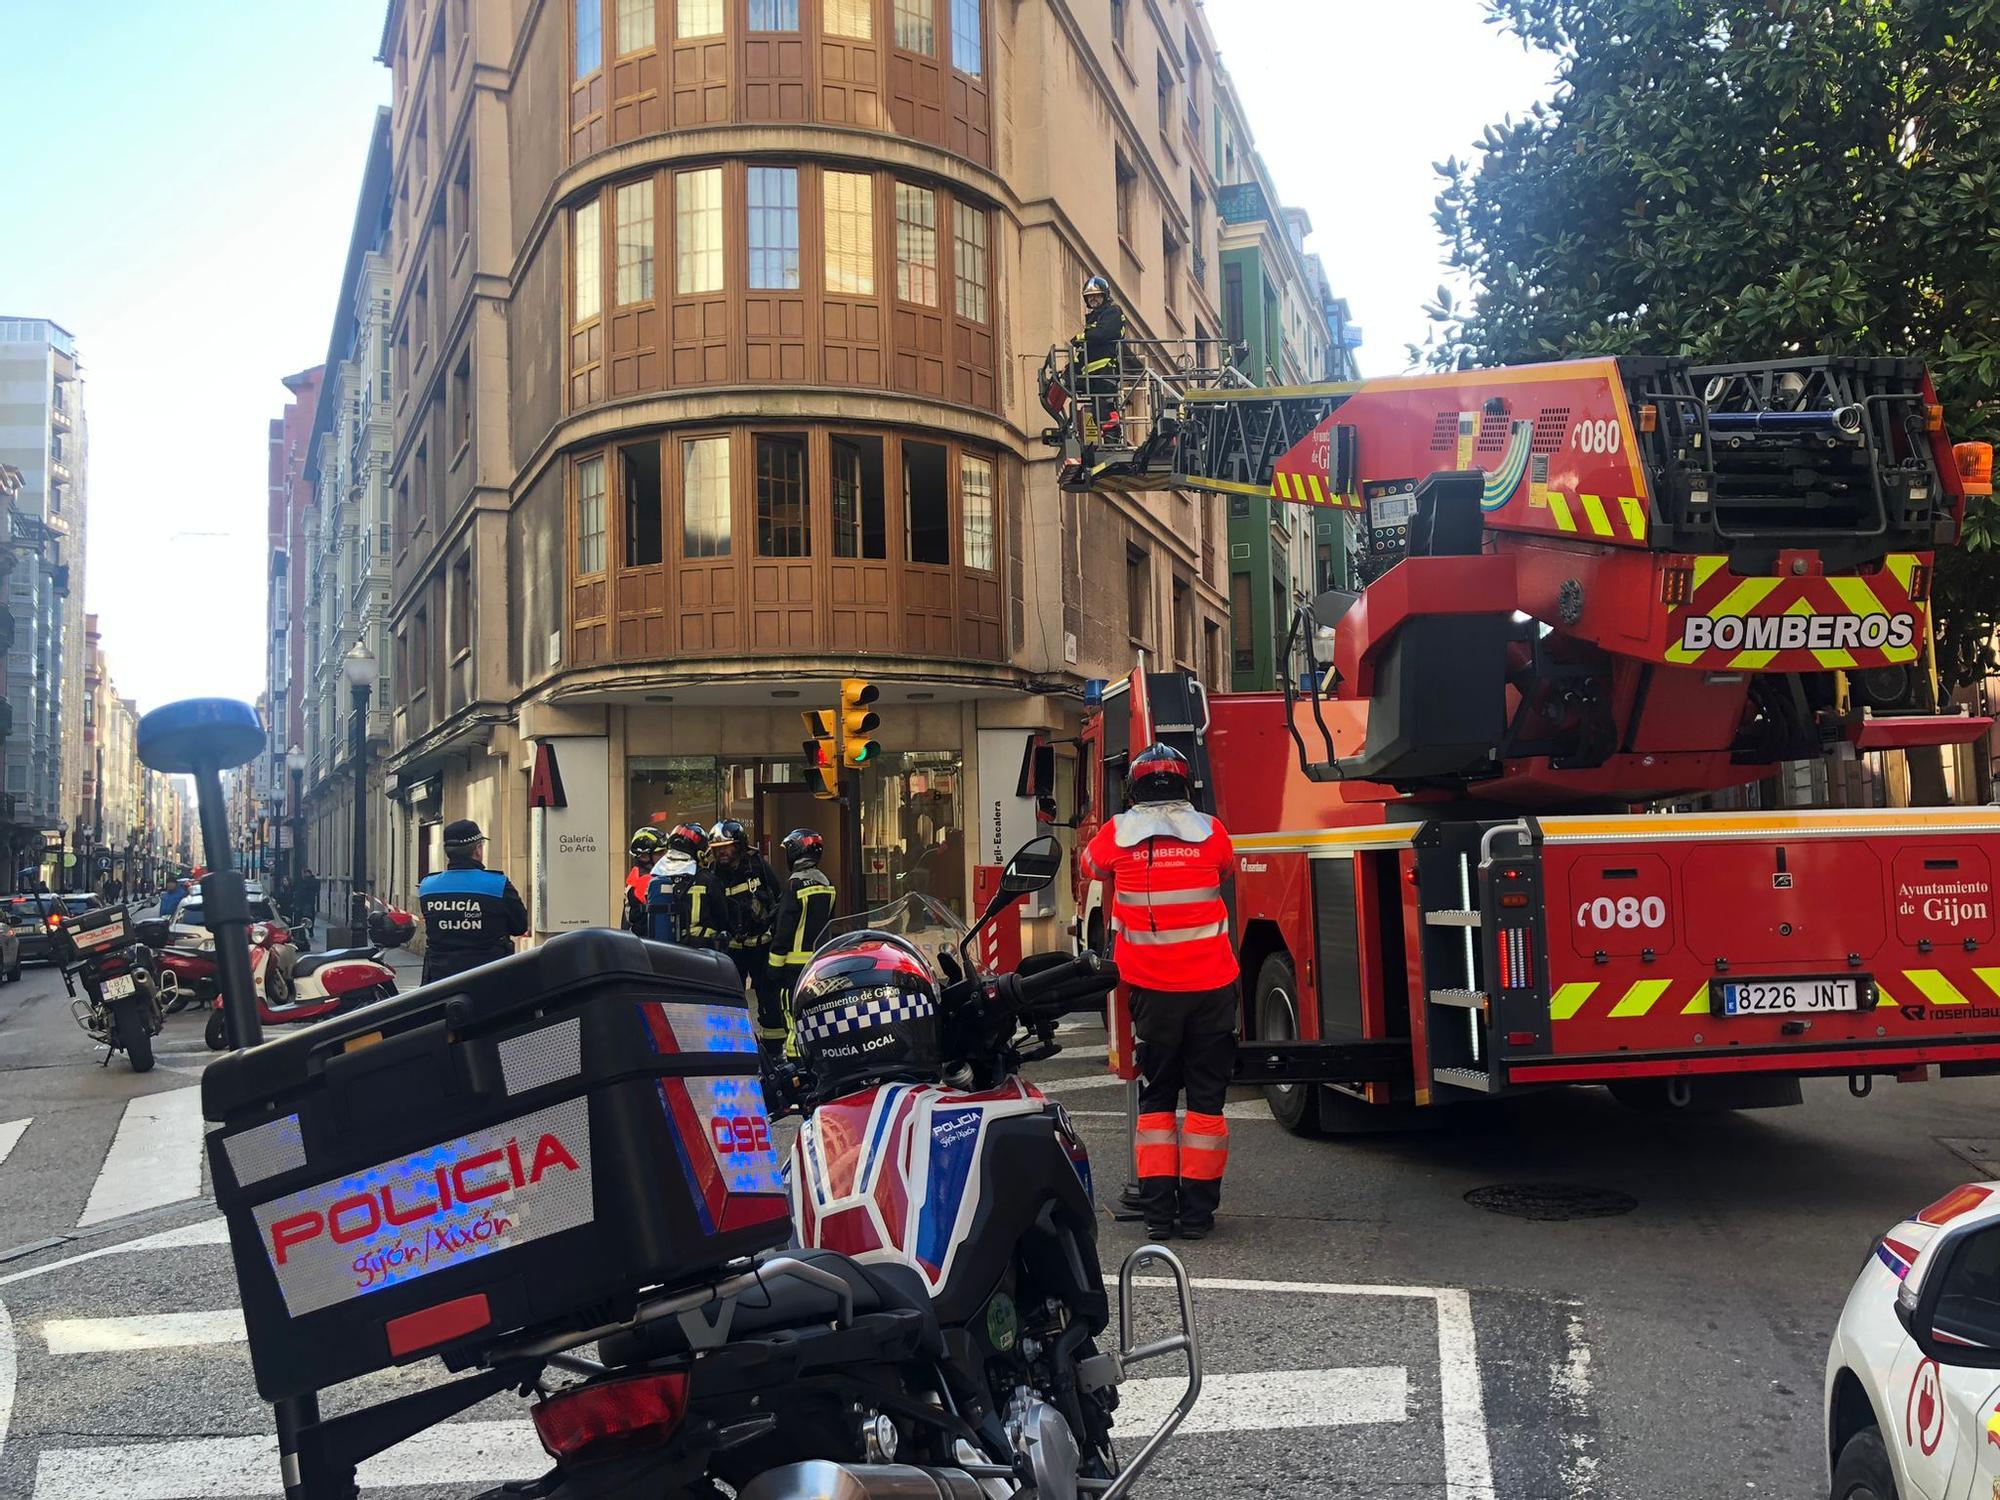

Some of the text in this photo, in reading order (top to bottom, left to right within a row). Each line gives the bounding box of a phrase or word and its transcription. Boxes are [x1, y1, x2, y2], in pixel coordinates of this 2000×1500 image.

[1581, 419, 1620, 454] 080
[1683, 613, 1914, 650] BOMBEROS
[559, 833, 594, 844] Galería
[993, 800, 1004, 865] igil-Escalera
[575, 843, 596, 853] Arte
[1132, 847, 1201, 860] BOMBEROS
[1899, 880, 1989, 899] Ayuntamiento
[427, 899, 481, 911] POLICÍA
[1591, 895, 1666, 930] 080
[1900, 897, 1988, 927] de Gijon
[438, 918, 482, 930] GIJÓN
[801, 995, 859, 1019] Ayuntamiento
[860, 989, 873, 1001] de
[1739, 984, 1849, 1010] 8226 JNT
[822, 1033, 896, 1058] POLICÍA LOCAL
[711, 1116, 771, 1153] 092
[270, 1133, 581, 1265] POLICÍA
